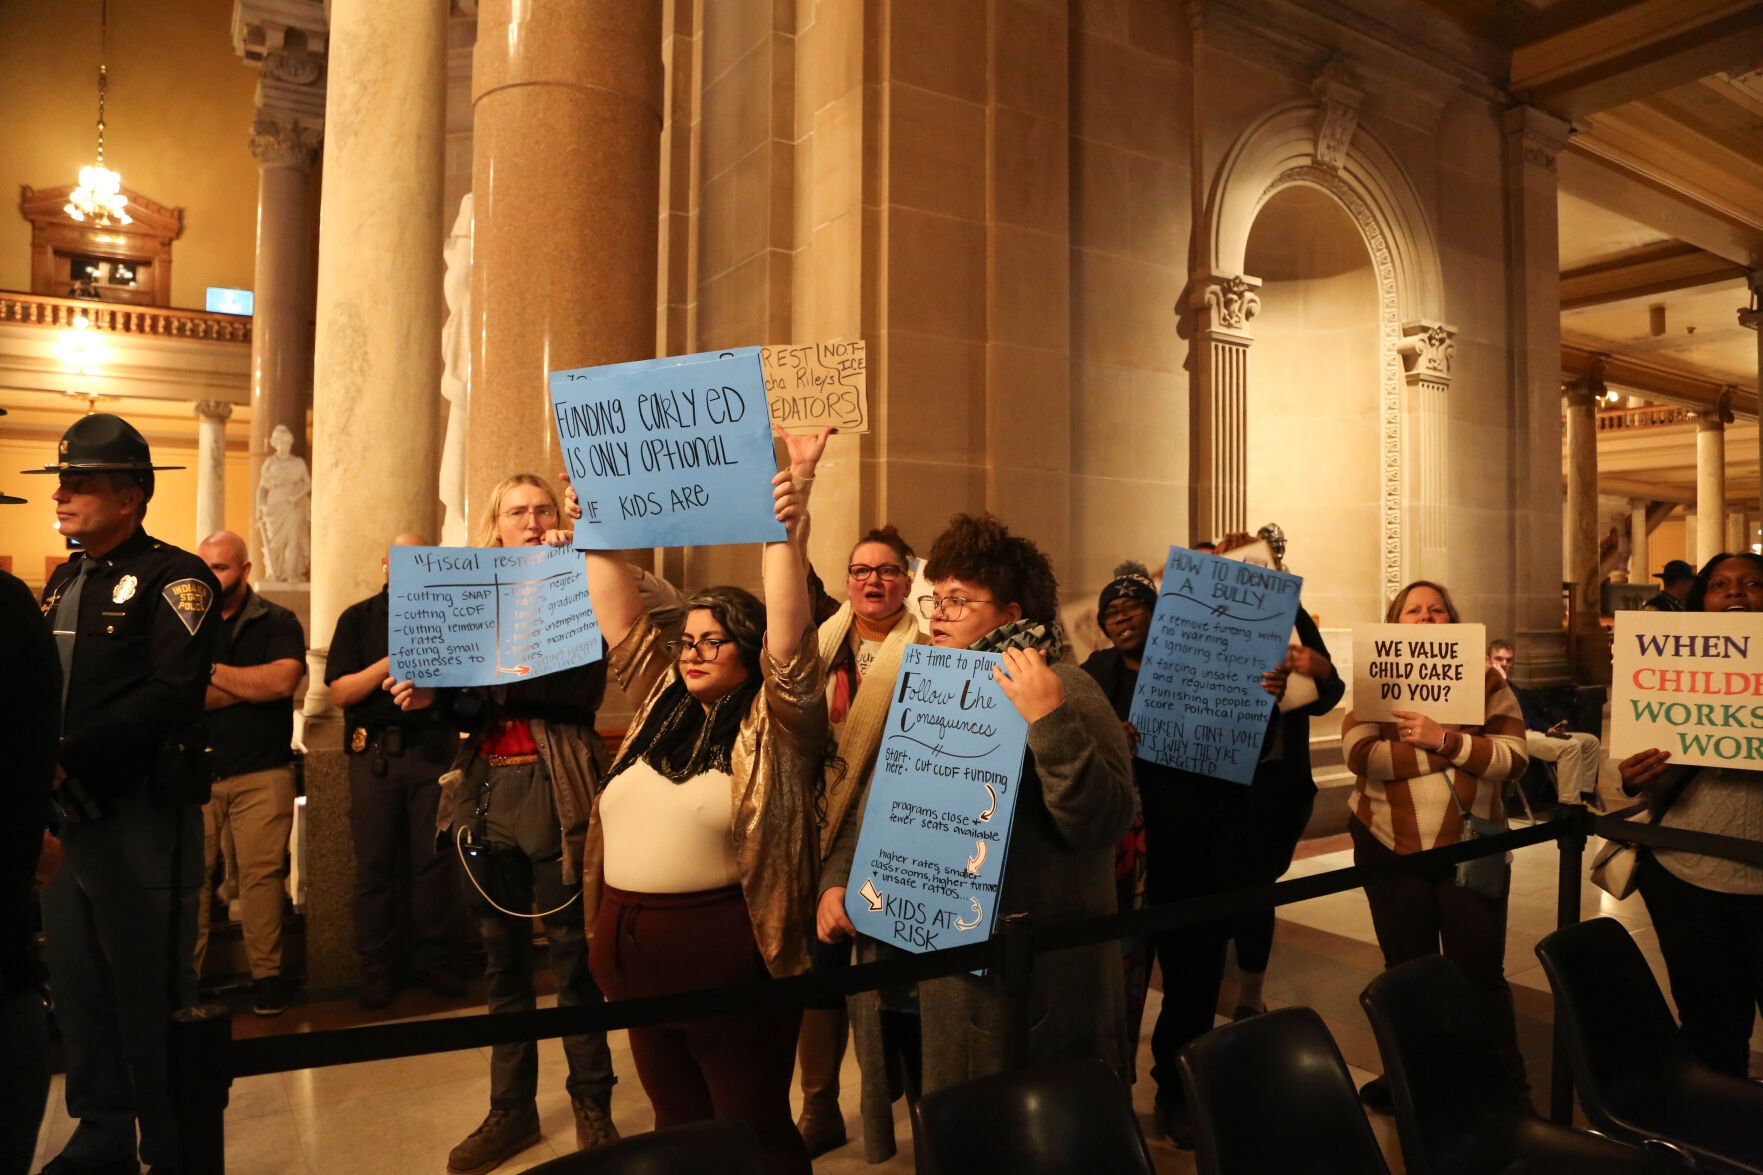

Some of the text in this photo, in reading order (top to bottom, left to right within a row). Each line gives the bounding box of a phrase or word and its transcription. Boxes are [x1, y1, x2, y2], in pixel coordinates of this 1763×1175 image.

[761, 346, 814, 369] REST
[837, 357, 865, 372] ICE
[796, 366, 835, 393] Riley's
[770, 391, 856, 422] EDATORS
[567, 446, 586, 479] IS
[590, 441, 632, 477] ONLY
[587, 500, 600, 522] IF
[619, 492, 663, 520] KIDS
[1169, 551, 1206, 576] HOW
[1211, 560, 1228, 582] TO
[549, 572, 582, 591] neglect
[1179, 578, 1194, 594] A
[461, 590, 492, 600] SNAP
[452, 604, 485, 617] CCDF
[448, 619, 495, 633] reimburse
[1161, 625, 1229, 650] no warning
[1169, 615, 1209, 632] remove
[1258, 630, 1282, 643] with
[411, 635, 445, 645] rates
[446, 642, 480, 655] small
[1374, 640, 1459, 659] WE VALUE
[1635, 634, 1751, 659] WHEN
[397, 657, 462, 669] businesses
[905, 648, 997, 680] it's time to play
[1157, 658, 1197, 676] forcing
[1202, 669, 1239, 682] unsafe
[1216, 651, 1267, 670] experts
[1369, 661, 1464, 681] CHILD CARE
[405, 668, 441, 680] close
[1152, 672, 1249, 696] and regulations
[897, 672, 997, 711] Follow the
[1151, 685, 1209, 706] punishing
[1215, 696, 1251, 708] people
[1255, 699, 1268, 707] to
[1381, 682, 1451, 703] DO YOU?
[900, 707, 997, 739] Consequences
[1144, 698, 1175, 711] score
[1237, 711, 1269, 724] points
[1630, 698, 1763, 729] WORKS
[1163, 736, 1188, 756] WHY
[1676, 732, 1763, 760] WOR
[933, 764, 961, 779] CCDF
[891, 800, 938, 820] programs
[941, 811, 969, 826] close
[889, 813, 1001, 842] fewer seats available
[879, 848, 908, 864] higher
[870, 859, 930, 883] classrooms,
[932, 875, 968, 889] higher
[882, 873, 917, 889] unsafe
[885, 893, 958, 930] KIDS AT
[894, 920, 939, 951] RISK
